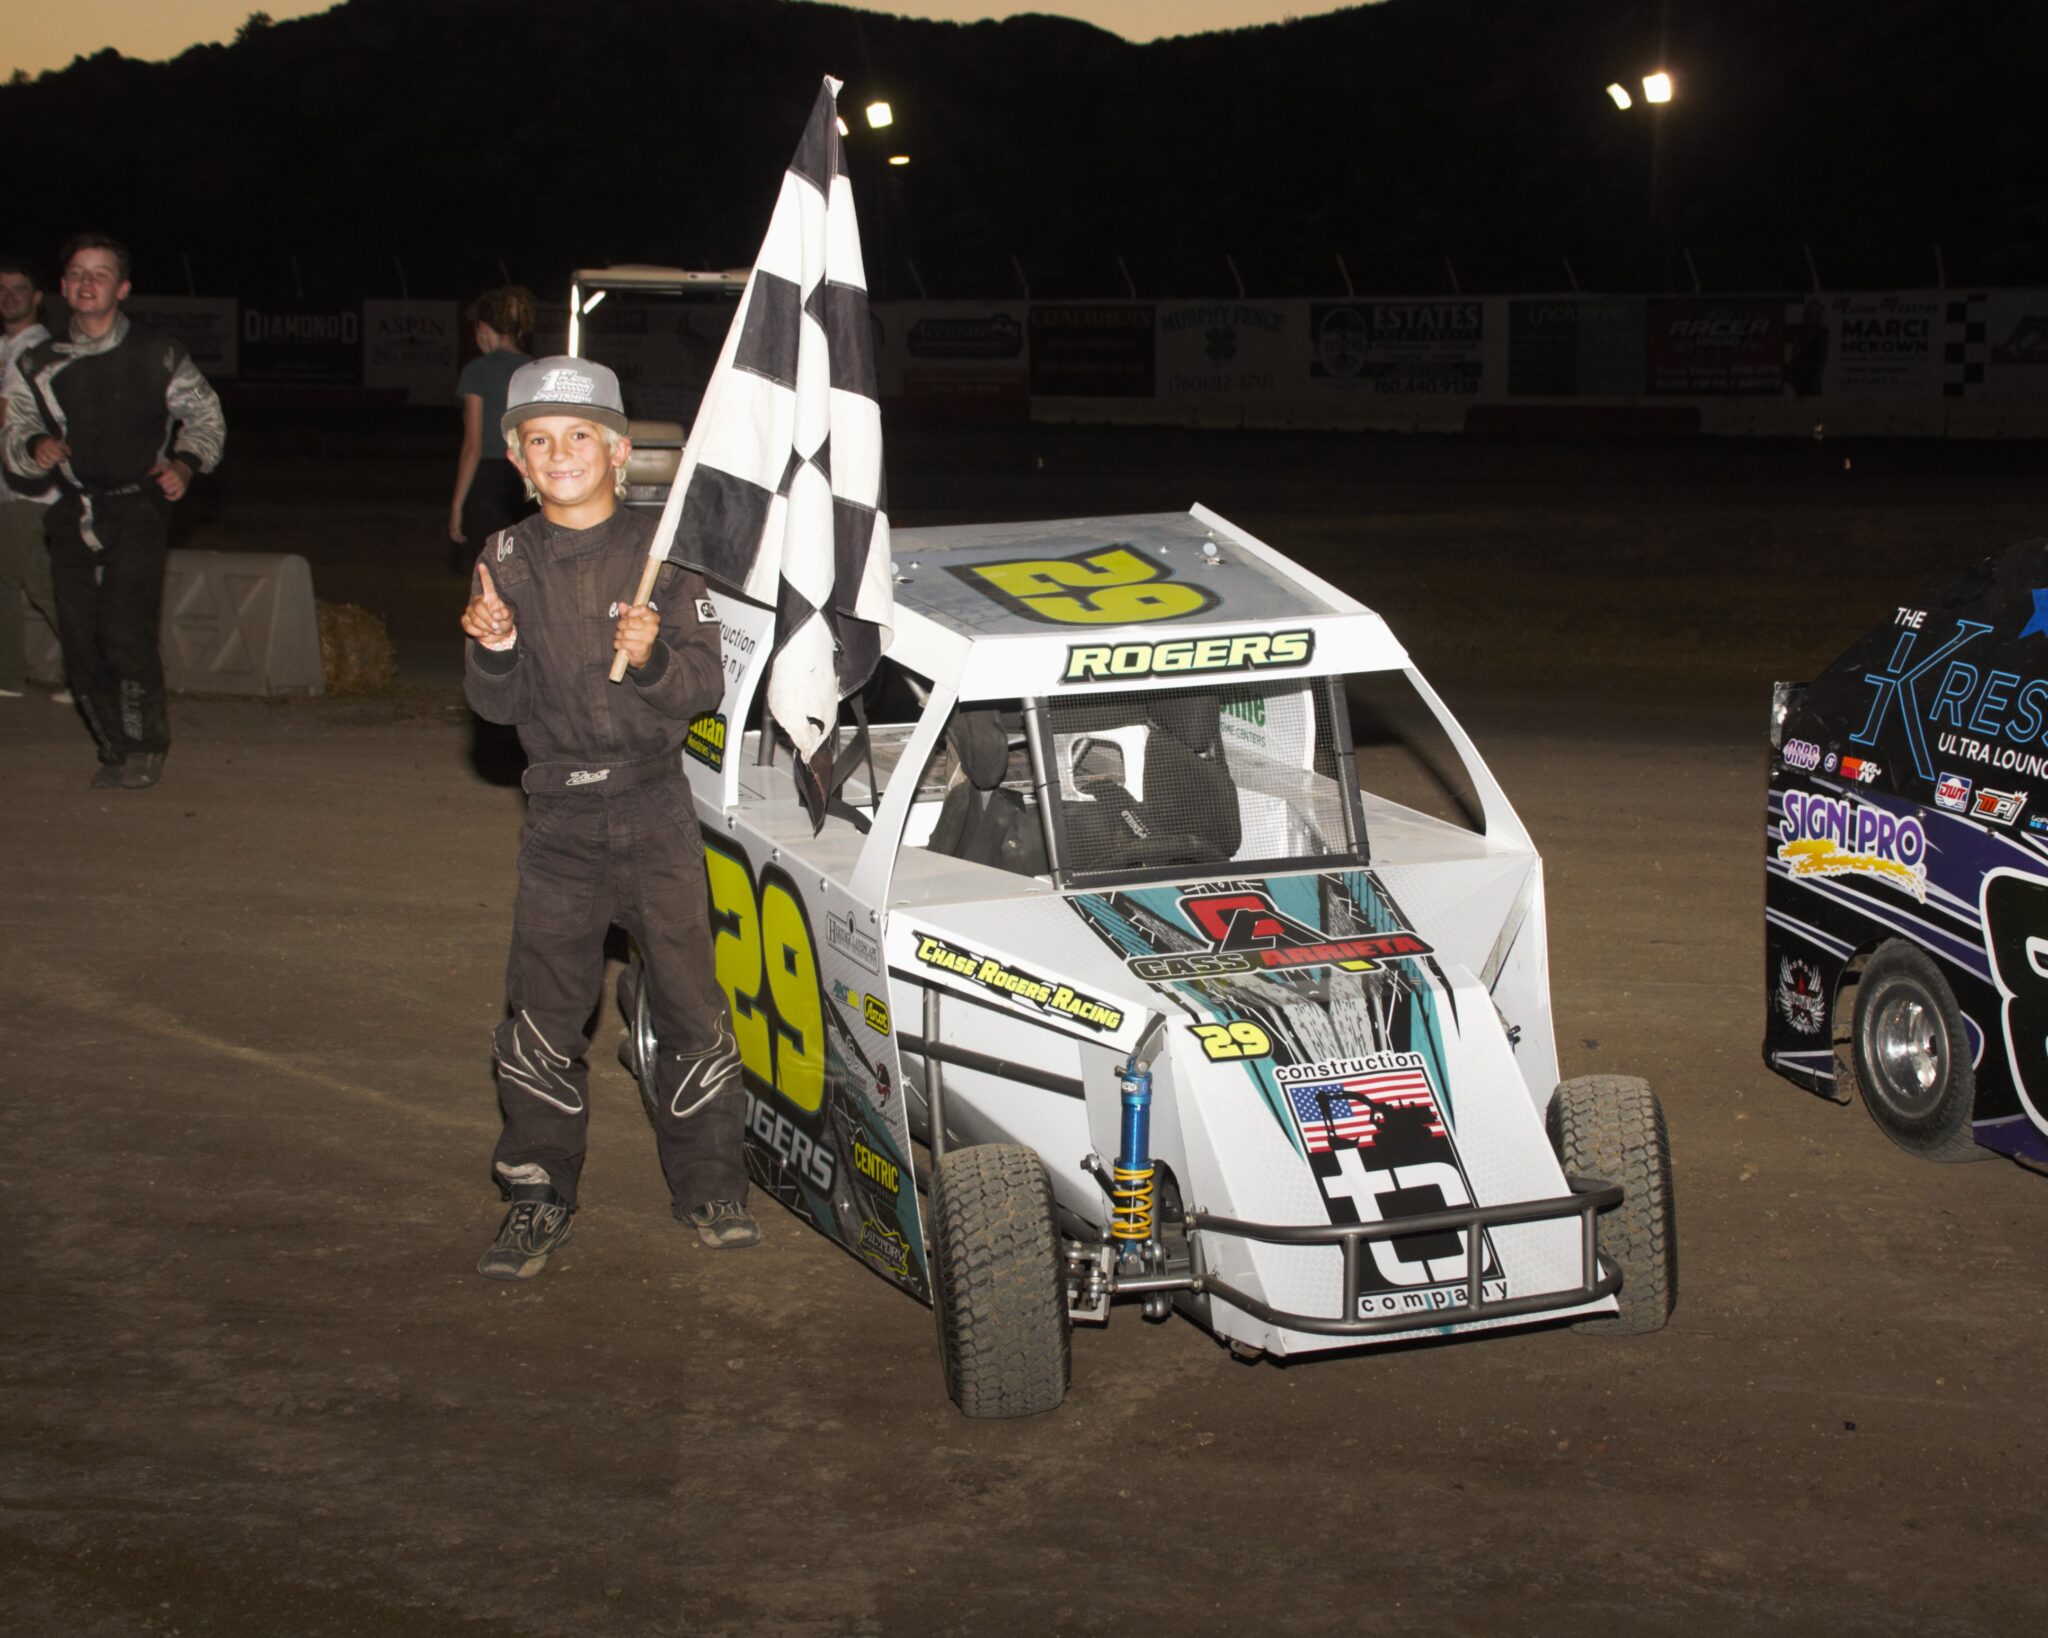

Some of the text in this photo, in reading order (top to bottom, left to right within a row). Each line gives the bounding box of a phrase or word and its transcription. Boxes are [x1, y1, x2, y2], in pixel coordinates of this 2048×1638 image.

[1373, 304, 1479, 330] ESTATES
[1668, 317, 1770, 336] RACER
[1841, 319, 1929, 338] MARCI
[1894, 607, 1927, 629] THE
[1067, 629, 1311, 679] ROGERS
[1849, 620, 2048, 782] KRES
[1937, 732, 1990, 763] ULTRA
[1781, 790, 1926, 867] SIGN PRO
[1136, 936, 1426, 978] CASS ARRIETA
[704, 846, 825, 1112] 29
[1192, 1022, 1271, 1059] 29
[1275, 1053, 1424, 1082] construction
[745, 1091, 835, 1192] GERS
[854, 1142, 900, 1194] CENTRIC
